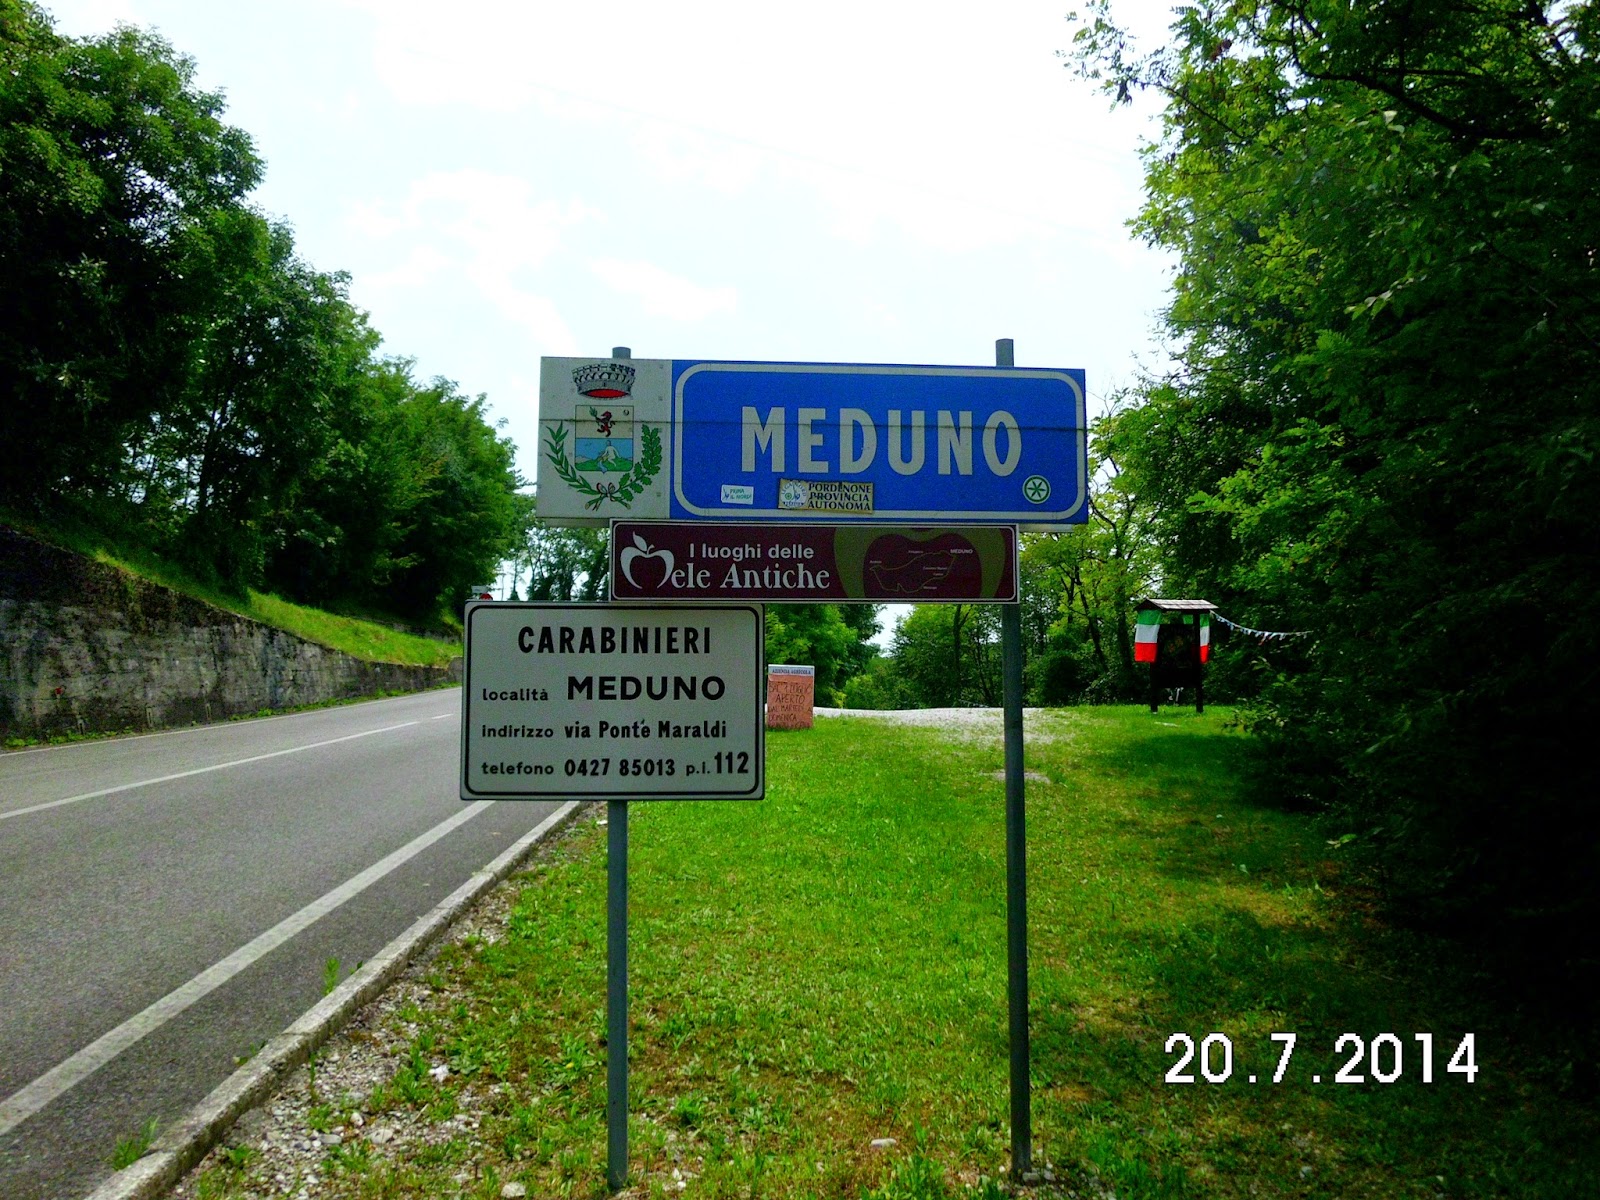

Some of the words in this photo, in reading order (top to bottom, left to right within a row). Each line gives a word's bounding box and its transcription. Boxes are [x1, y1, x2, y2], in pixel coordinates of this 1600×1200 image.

[740, 406, 1022, 477] MEDUNO
[808, 483, 872, 493] PORDENONE
[809, 492, 869, 501] PROVINCIA
[808, 501, 871, 511] AUTONOMA
[689, 543, 695, 558] I
[702, 543, 761, 562] luoghi
[768, 544, 814, 559] delle
[720, 563, 830, 590] Antiche
[518, 626, 711, 654] CARABINIERI
[482, 688, 549, 701] località
[567, 676, 726, 700] MEDUNO
[481, 725, 554, 738] indirizzo
[564, 721, 591, 738] via
[658, 720, 727, 738] Maraldi
[481, 761, 554, 775] telefono
[564, 758, 610, 776] 0427
[619, 758, 675, 776] 85013
[714, 752, 749, 774] 112
